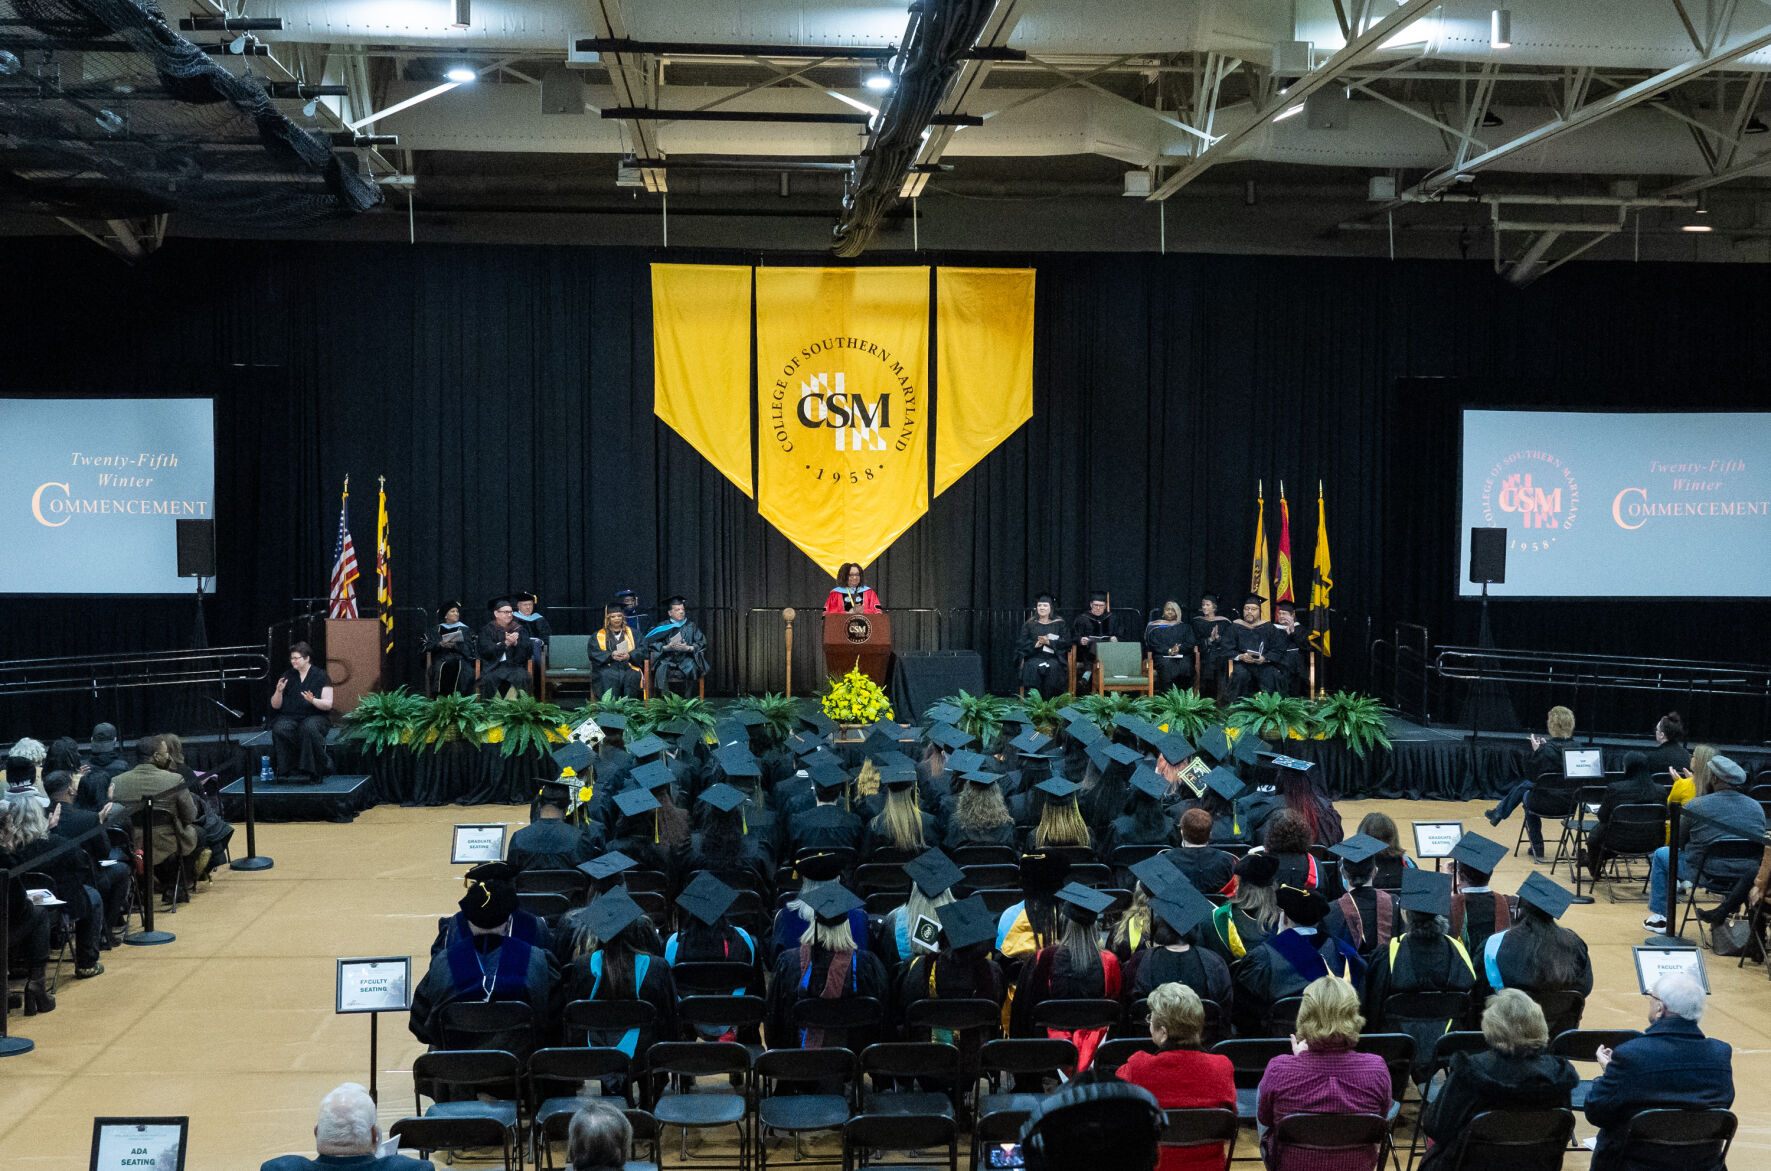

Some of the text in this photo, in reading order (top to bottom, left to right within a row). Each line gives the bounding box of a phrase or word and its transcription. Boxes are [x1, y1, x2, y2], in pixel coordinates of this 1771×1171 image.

[772, 337, 916, 453] COLLEGE OF SOUTHERN MARYLAND
[796, 392, 892, 429] CSM
[71, 452, 179, 471] Twenty-Fifth
[1650, 459, 1747, 475] Twenty-Fifth
[98, 473, 154, 488] Winter
[1503, 449, 1562, 468] SOUTHERN
[1562, 467, 1580, 530] MARYLAND
[1672, 478, 1724, 491] Winter
[31, 482, 208, 527] COMMENCEMENT
[1498, 487, 1562, 513] CSM
[1612, 487, 1771, 530] COMMENCEMENT
[849, 625, 866, 633] CSM
